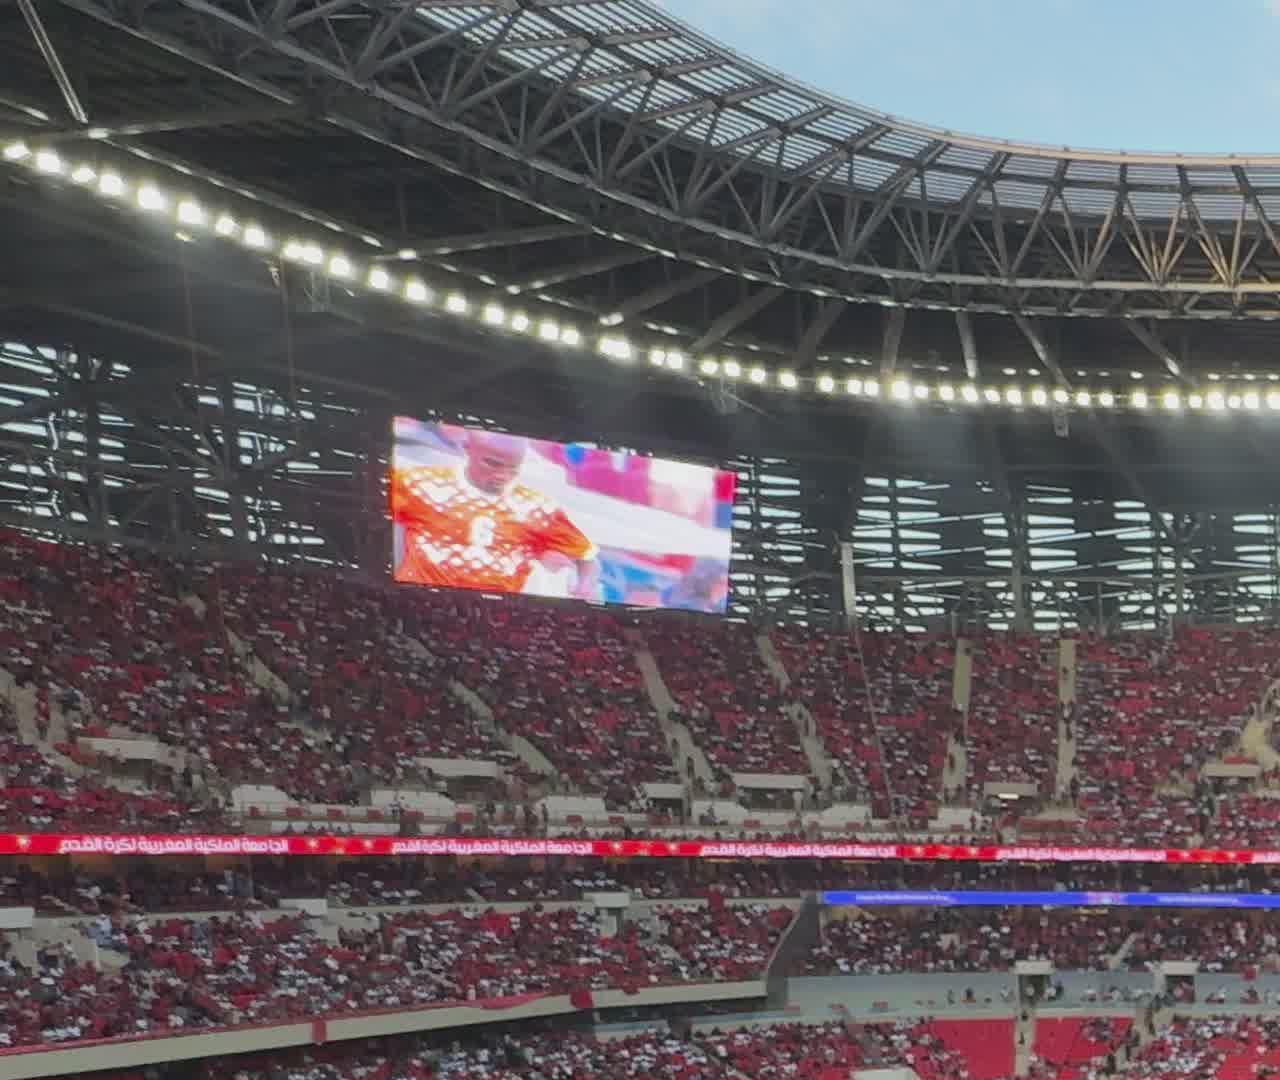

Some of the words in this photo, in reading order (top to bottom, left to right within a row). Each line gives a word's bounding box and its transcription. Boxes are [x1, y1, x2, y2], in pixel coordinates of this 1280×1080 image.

[59, 837, 102, 854] القدم
[104, 836, 137, 854] لكرة
[194, 837, 240, 854] الملكية
[242, 837, 288, 854] الجامعة
